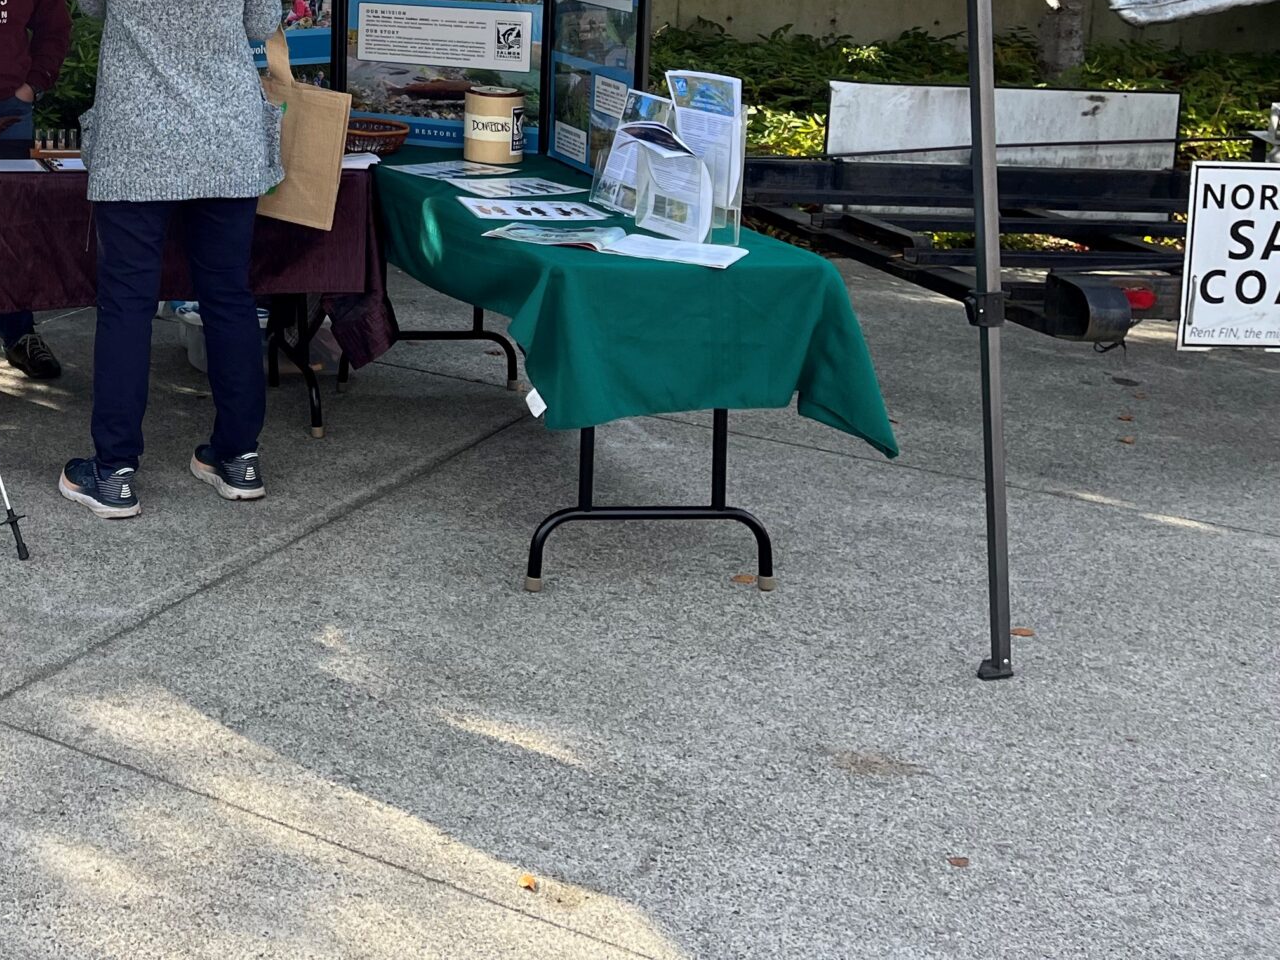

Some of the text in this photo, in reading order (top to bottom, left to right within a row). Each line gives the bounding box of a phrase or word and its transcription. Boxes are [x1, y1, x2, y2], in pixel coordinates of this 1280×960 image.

[415, 128, 457, 138] RESTORE
[1199, 269, 1280, 305] CO
[1190, 326, 1215, 339] Rent
[1218, 327, 1240, 340] FIN,
[1244, 328, 1263, 339] the
